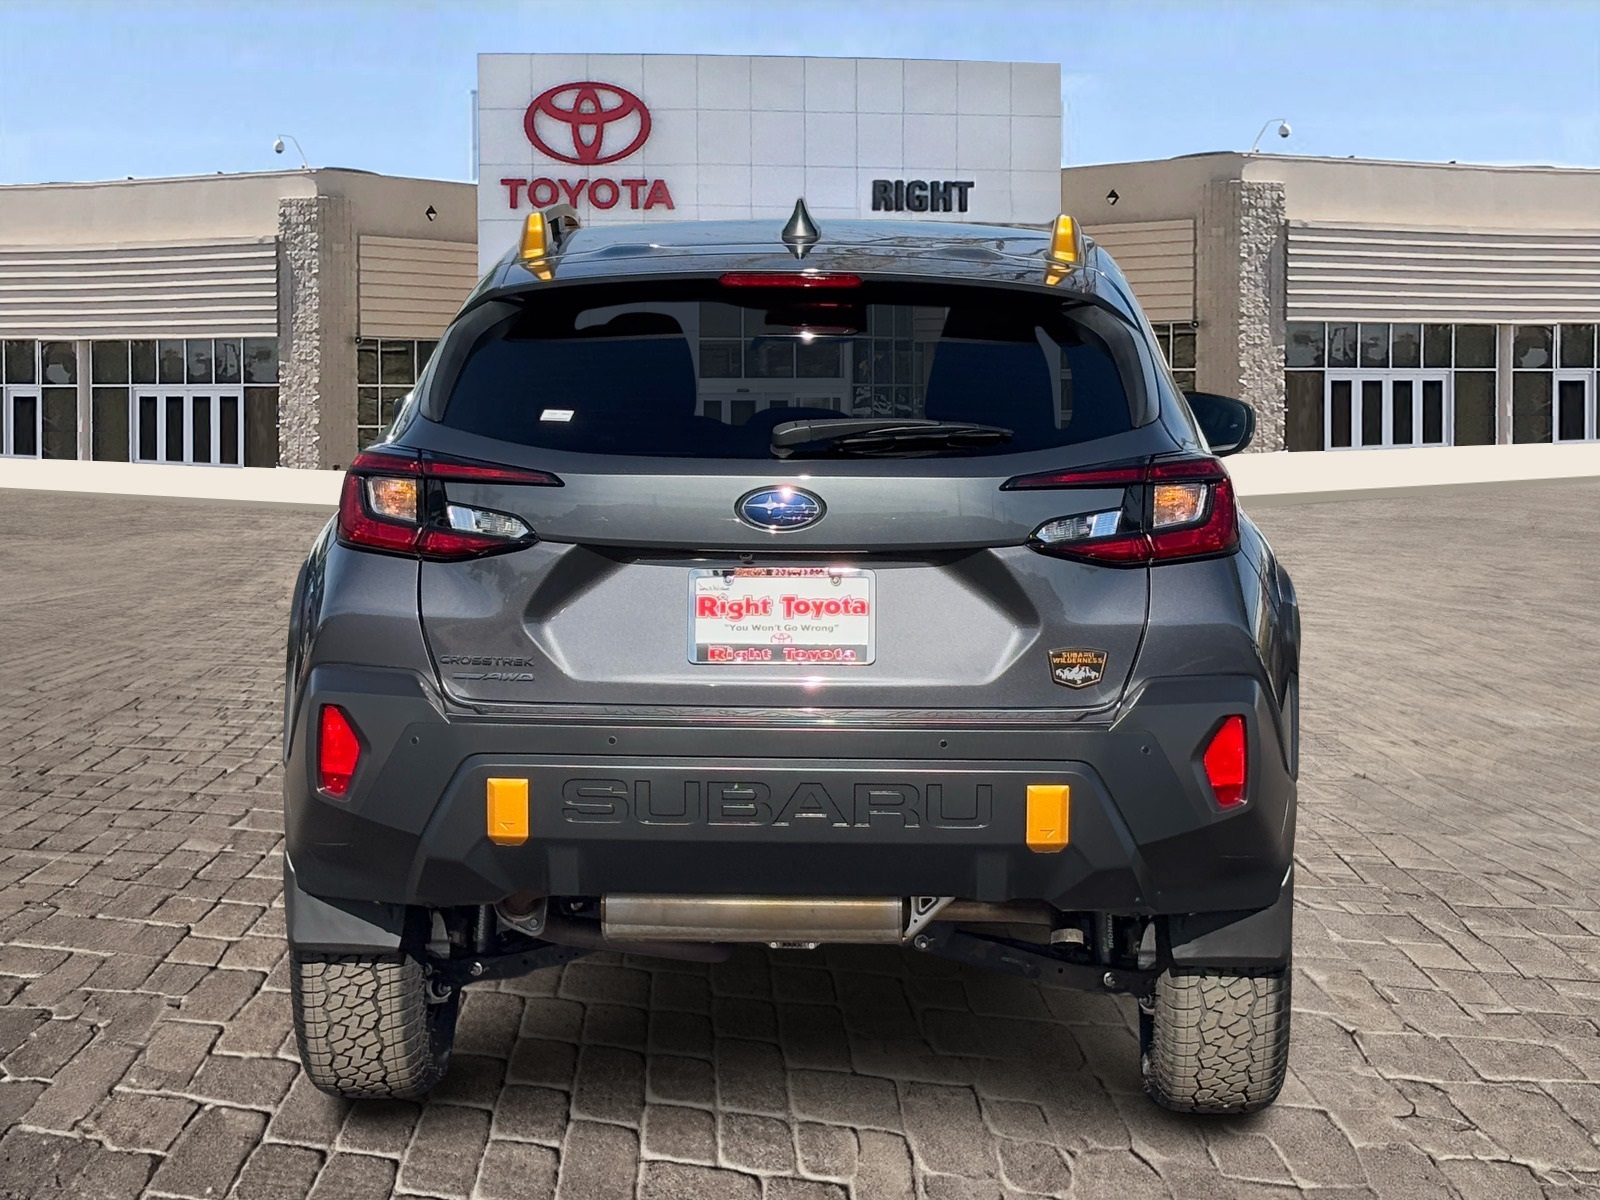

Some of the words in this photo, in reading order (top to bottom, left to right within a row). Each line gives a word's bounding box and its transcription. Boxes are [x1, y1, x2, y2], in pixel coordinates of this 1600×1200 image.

[500, 178, 675, 211] TOYOTA
[870, 179, 975, 213] RIGHT
[696, 594, 774, 622] Right
[780, 594, 870, 620] Toyota
[724, 624, 748, 632] "You
[752, 624, 781, 632] Won't
[784, 624, 798, 632] Go
[800, 624, 839, 633] Wrong"
[440, 655, 535, 667] CROSSTREK
[708, 646, 772, 662] Right
[783, 647, 857, 662] Toyota
[482, 672, 535, 682] AWD
[562, 777, 993, 829] SUBARU
